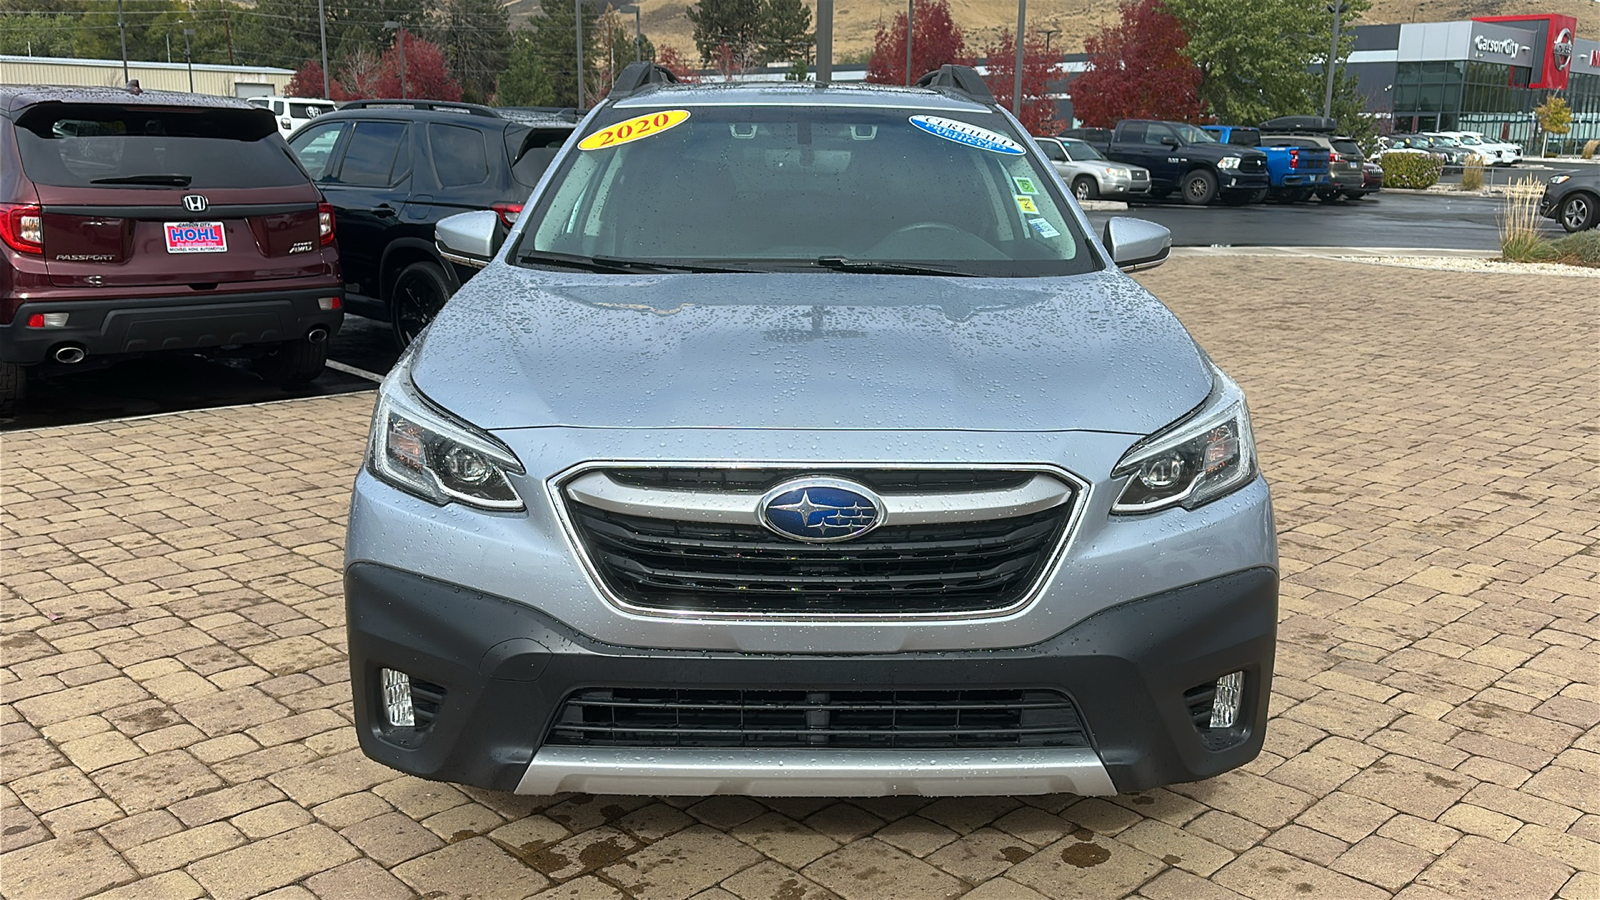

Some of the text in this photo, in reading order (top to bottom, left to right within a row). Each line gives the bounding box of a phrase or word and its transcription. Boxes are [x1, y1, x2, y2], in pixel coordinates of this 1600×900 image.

[1475, 35, 1519, 58] Carson City
[599, 114, 669, 146] 2020
[925, 117, 1015, 147] CERTIFIED
[171, 228, 219, 241] HOHL
